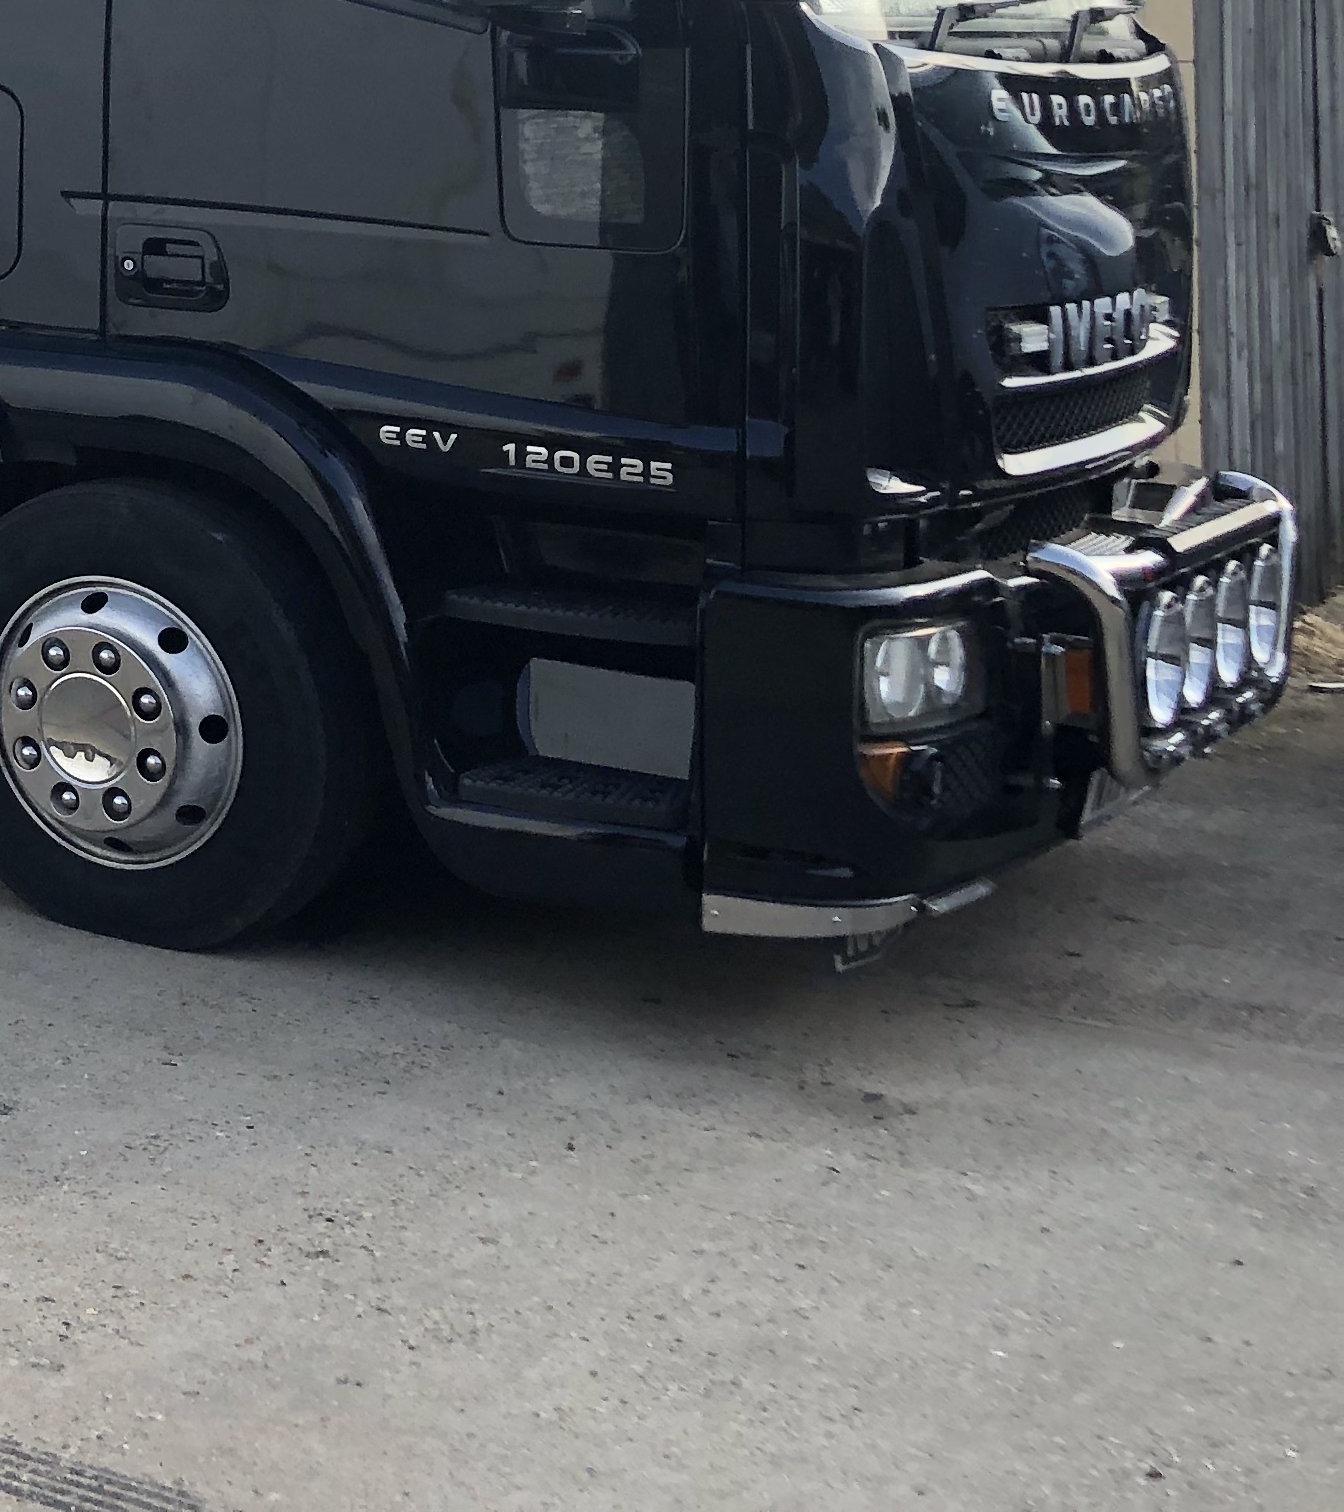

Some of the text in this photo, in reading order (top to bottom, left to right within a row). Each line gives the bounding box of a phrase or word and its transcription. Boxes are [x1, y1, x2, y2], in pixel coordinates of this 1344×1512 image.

[1048, 288, 1153, 375] IVECO
[379, 425, 673, 486] EEV 120E25
